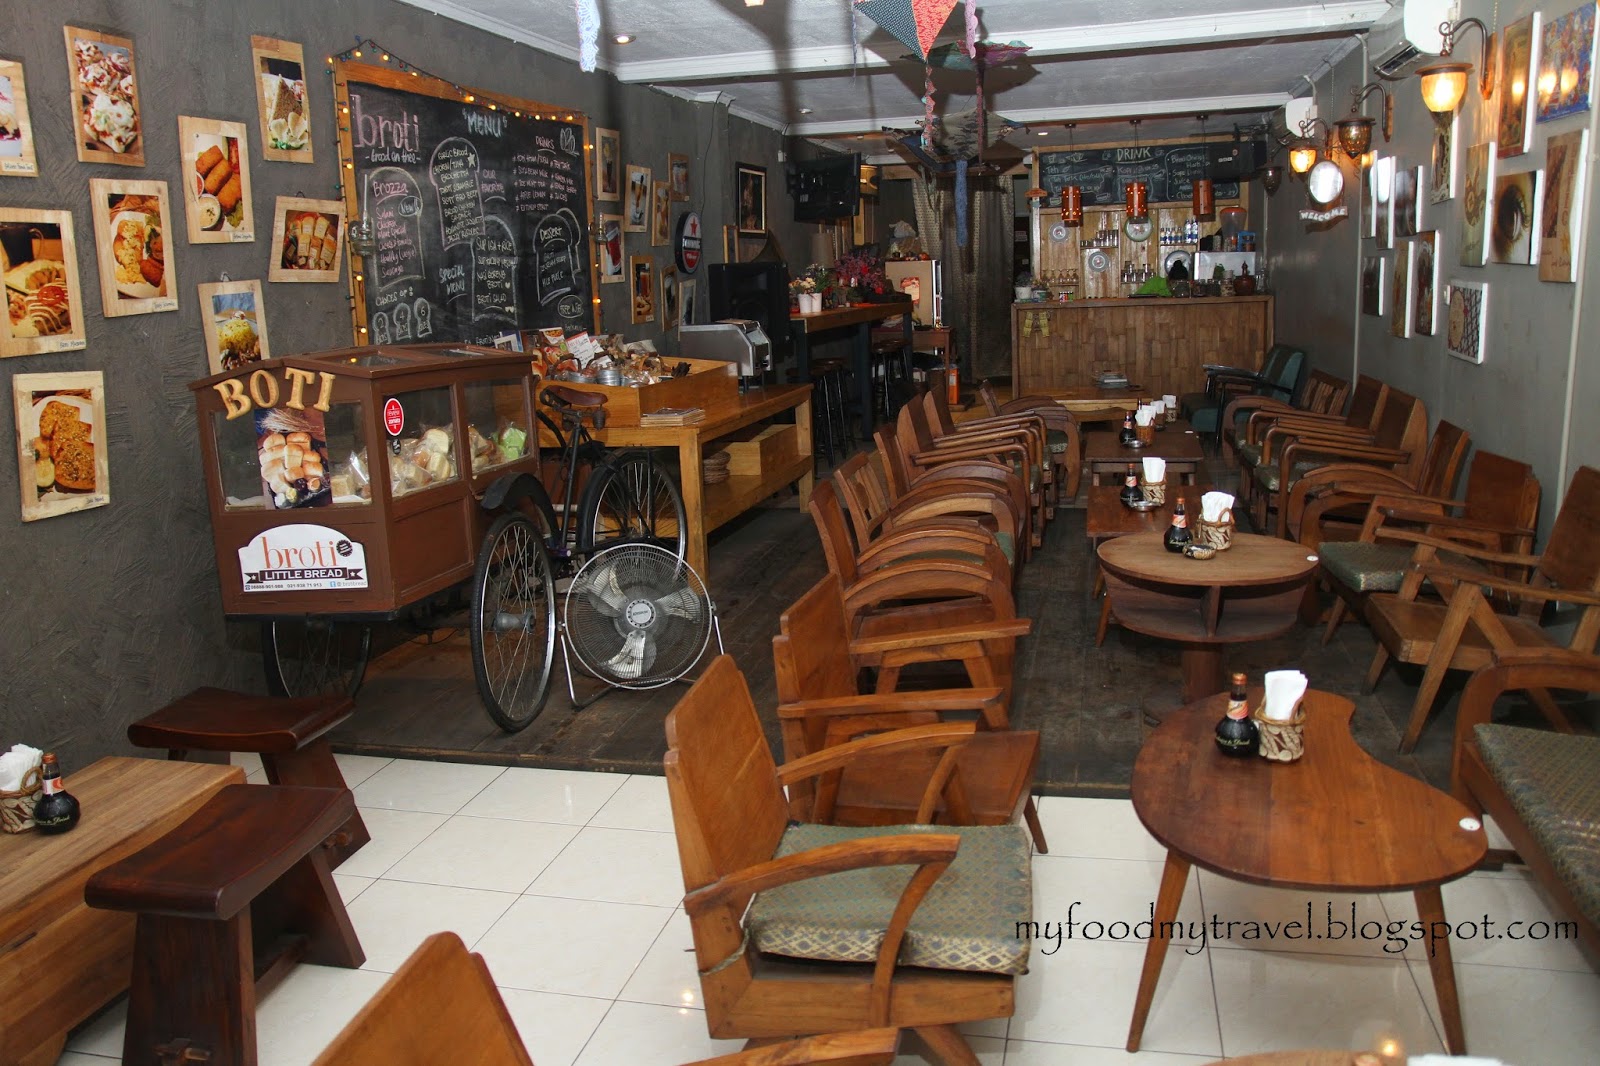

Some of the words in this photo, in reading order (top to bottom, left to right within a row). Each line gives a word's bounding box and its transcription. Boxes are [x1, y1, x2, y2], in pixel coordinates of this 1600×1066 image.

[350, 94, 419, 152] broti
[1117, 147, 1151, 162] DRINK
[373, 181, 409, 197] Brozza
[1300, 209, 1346, 221] WELCOME
[213, 367, 336, 420] BOTI
[260, 536, 339, 569] broti
[265, 571, 302, 580] LITTLE
[304, 569, 343, 579] BREAD
